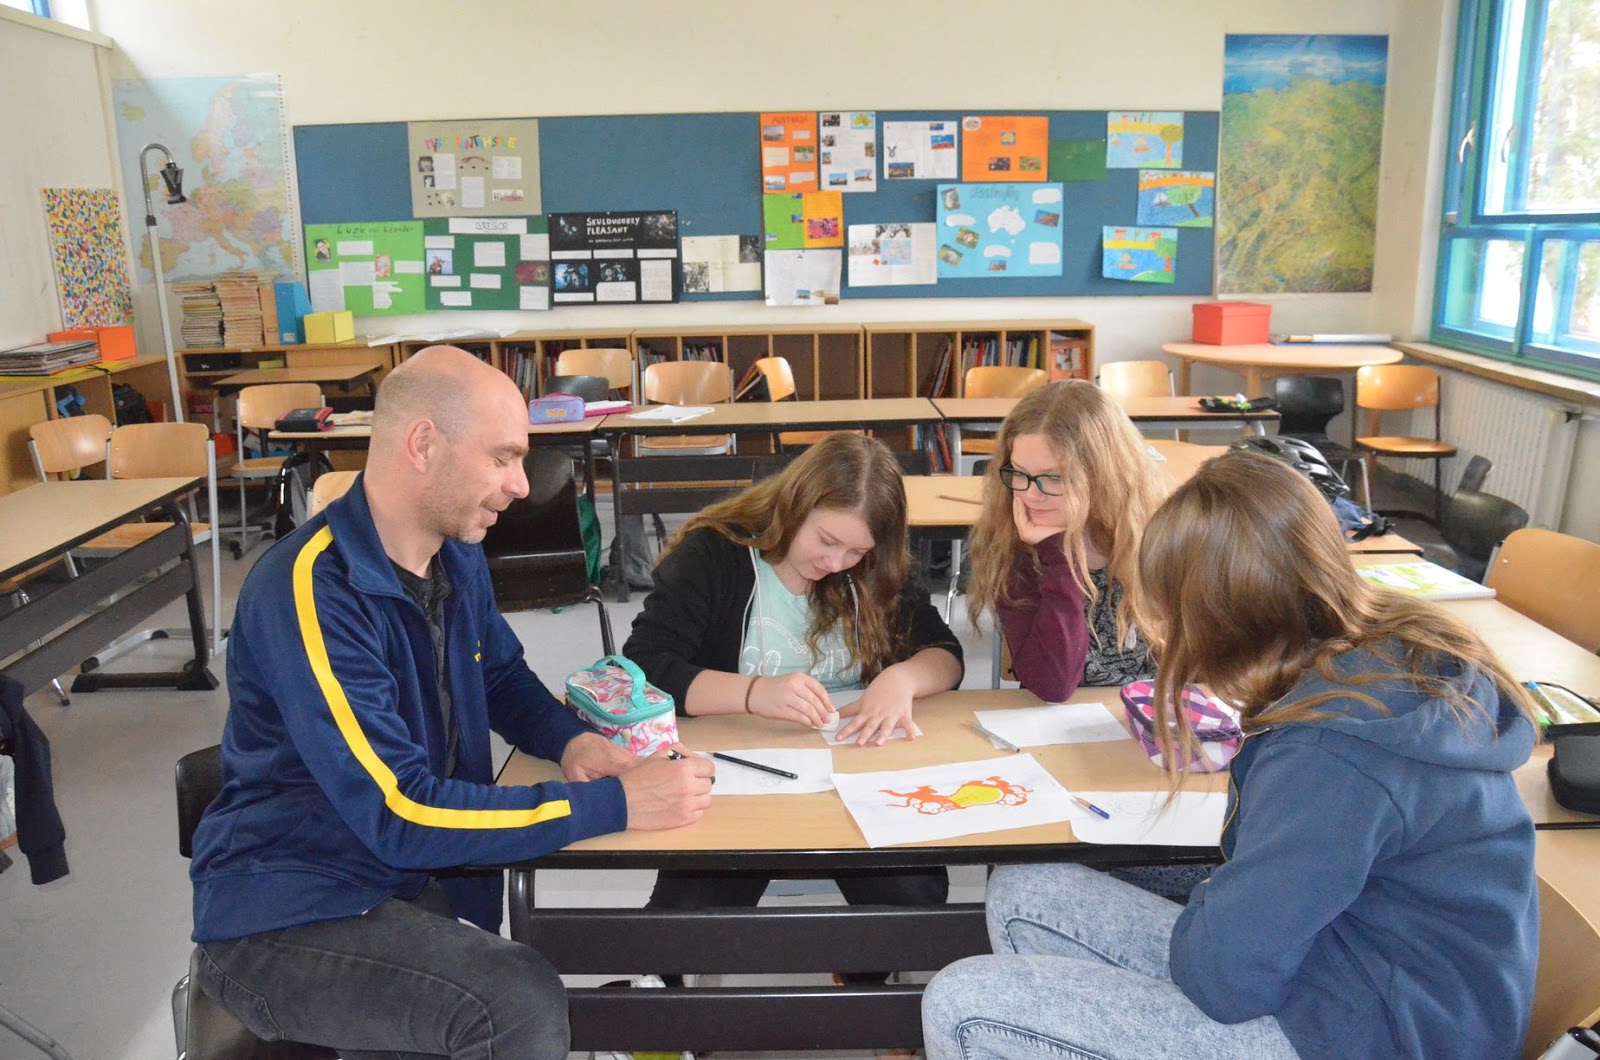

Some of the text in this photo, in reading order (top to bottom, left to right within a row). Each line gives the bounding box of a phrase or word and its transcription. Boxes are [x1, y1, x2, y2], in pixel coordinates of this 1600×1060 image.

[586, 217, 640, 226] SKULDUGGERY
[475, 222, 509, 231] GREGOR
[587, 226, 628, 235] PLEASANT
